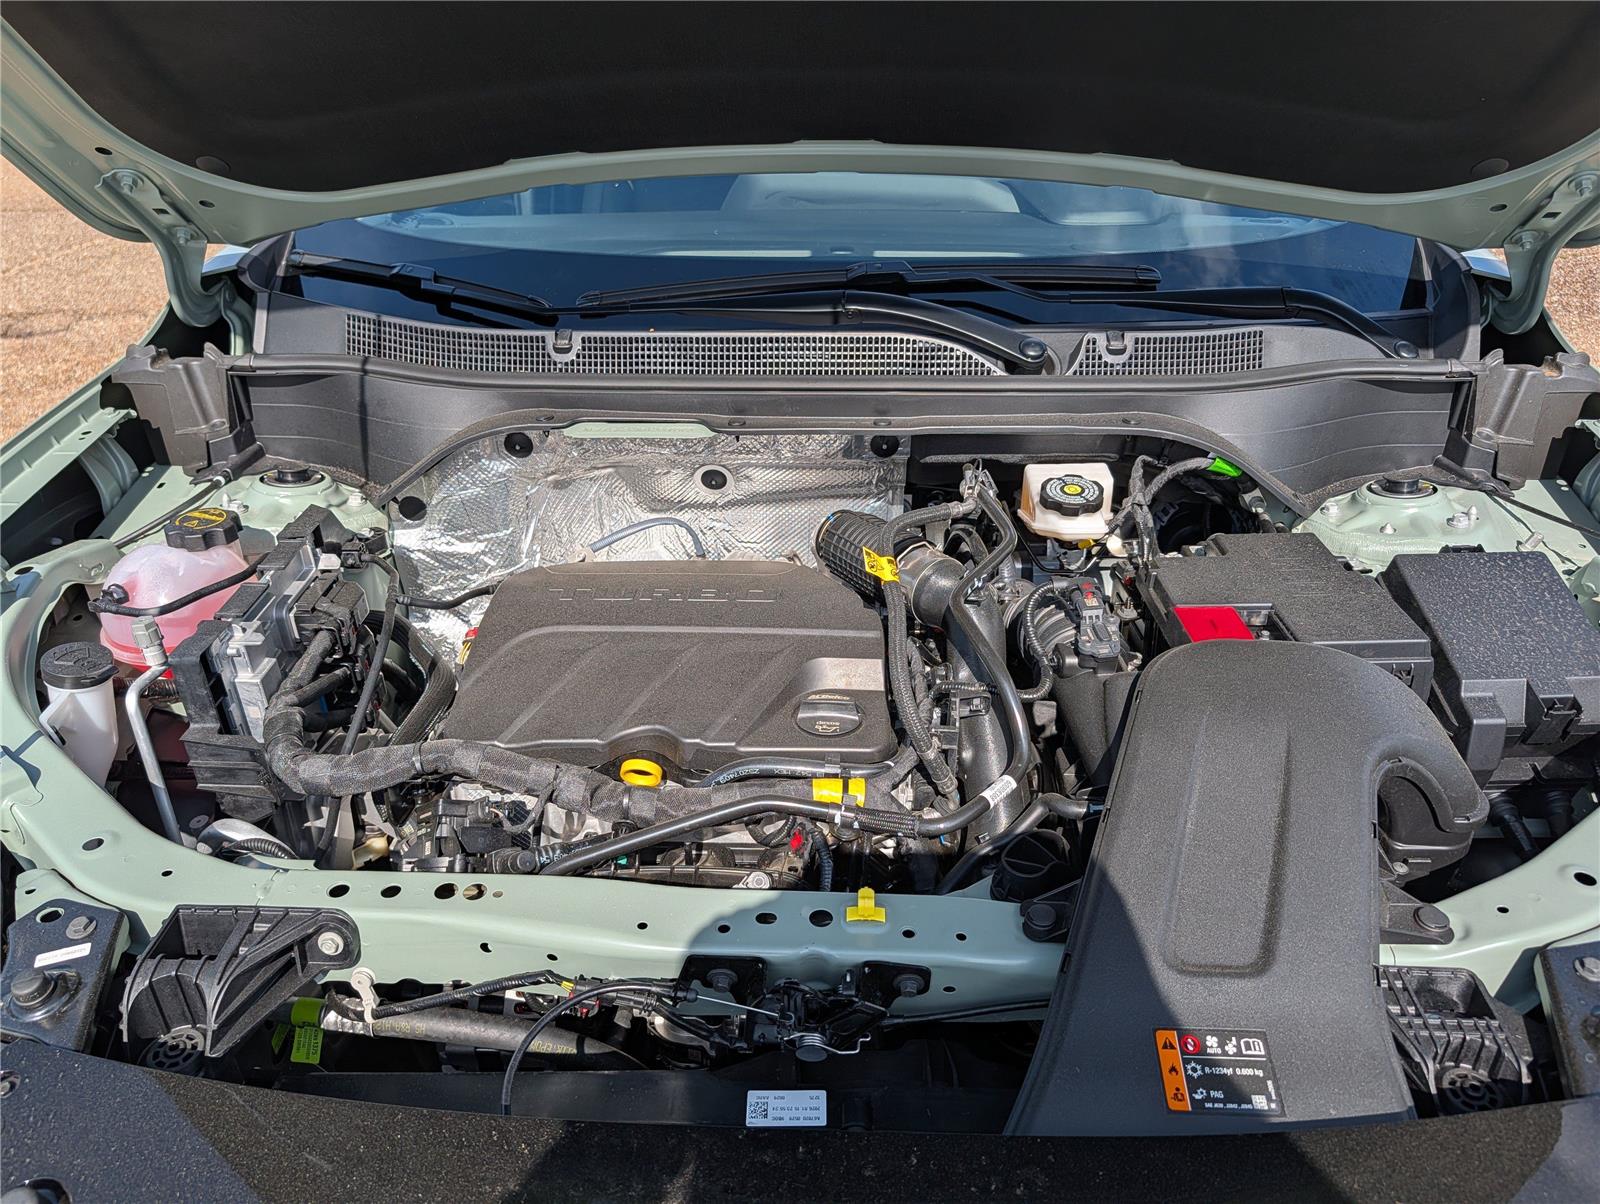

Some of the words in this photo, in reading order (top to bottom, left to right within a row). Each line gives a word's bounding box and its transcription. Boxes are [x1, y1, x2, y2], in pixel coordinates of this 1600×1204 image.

[548, 588, 777, 603] TURBO
[1204, 1066, 1233, 1077] R-1234yf
[1254, 1067, 1264, 1077] kg
[1210, 1090, 1224, 1099] PAG
